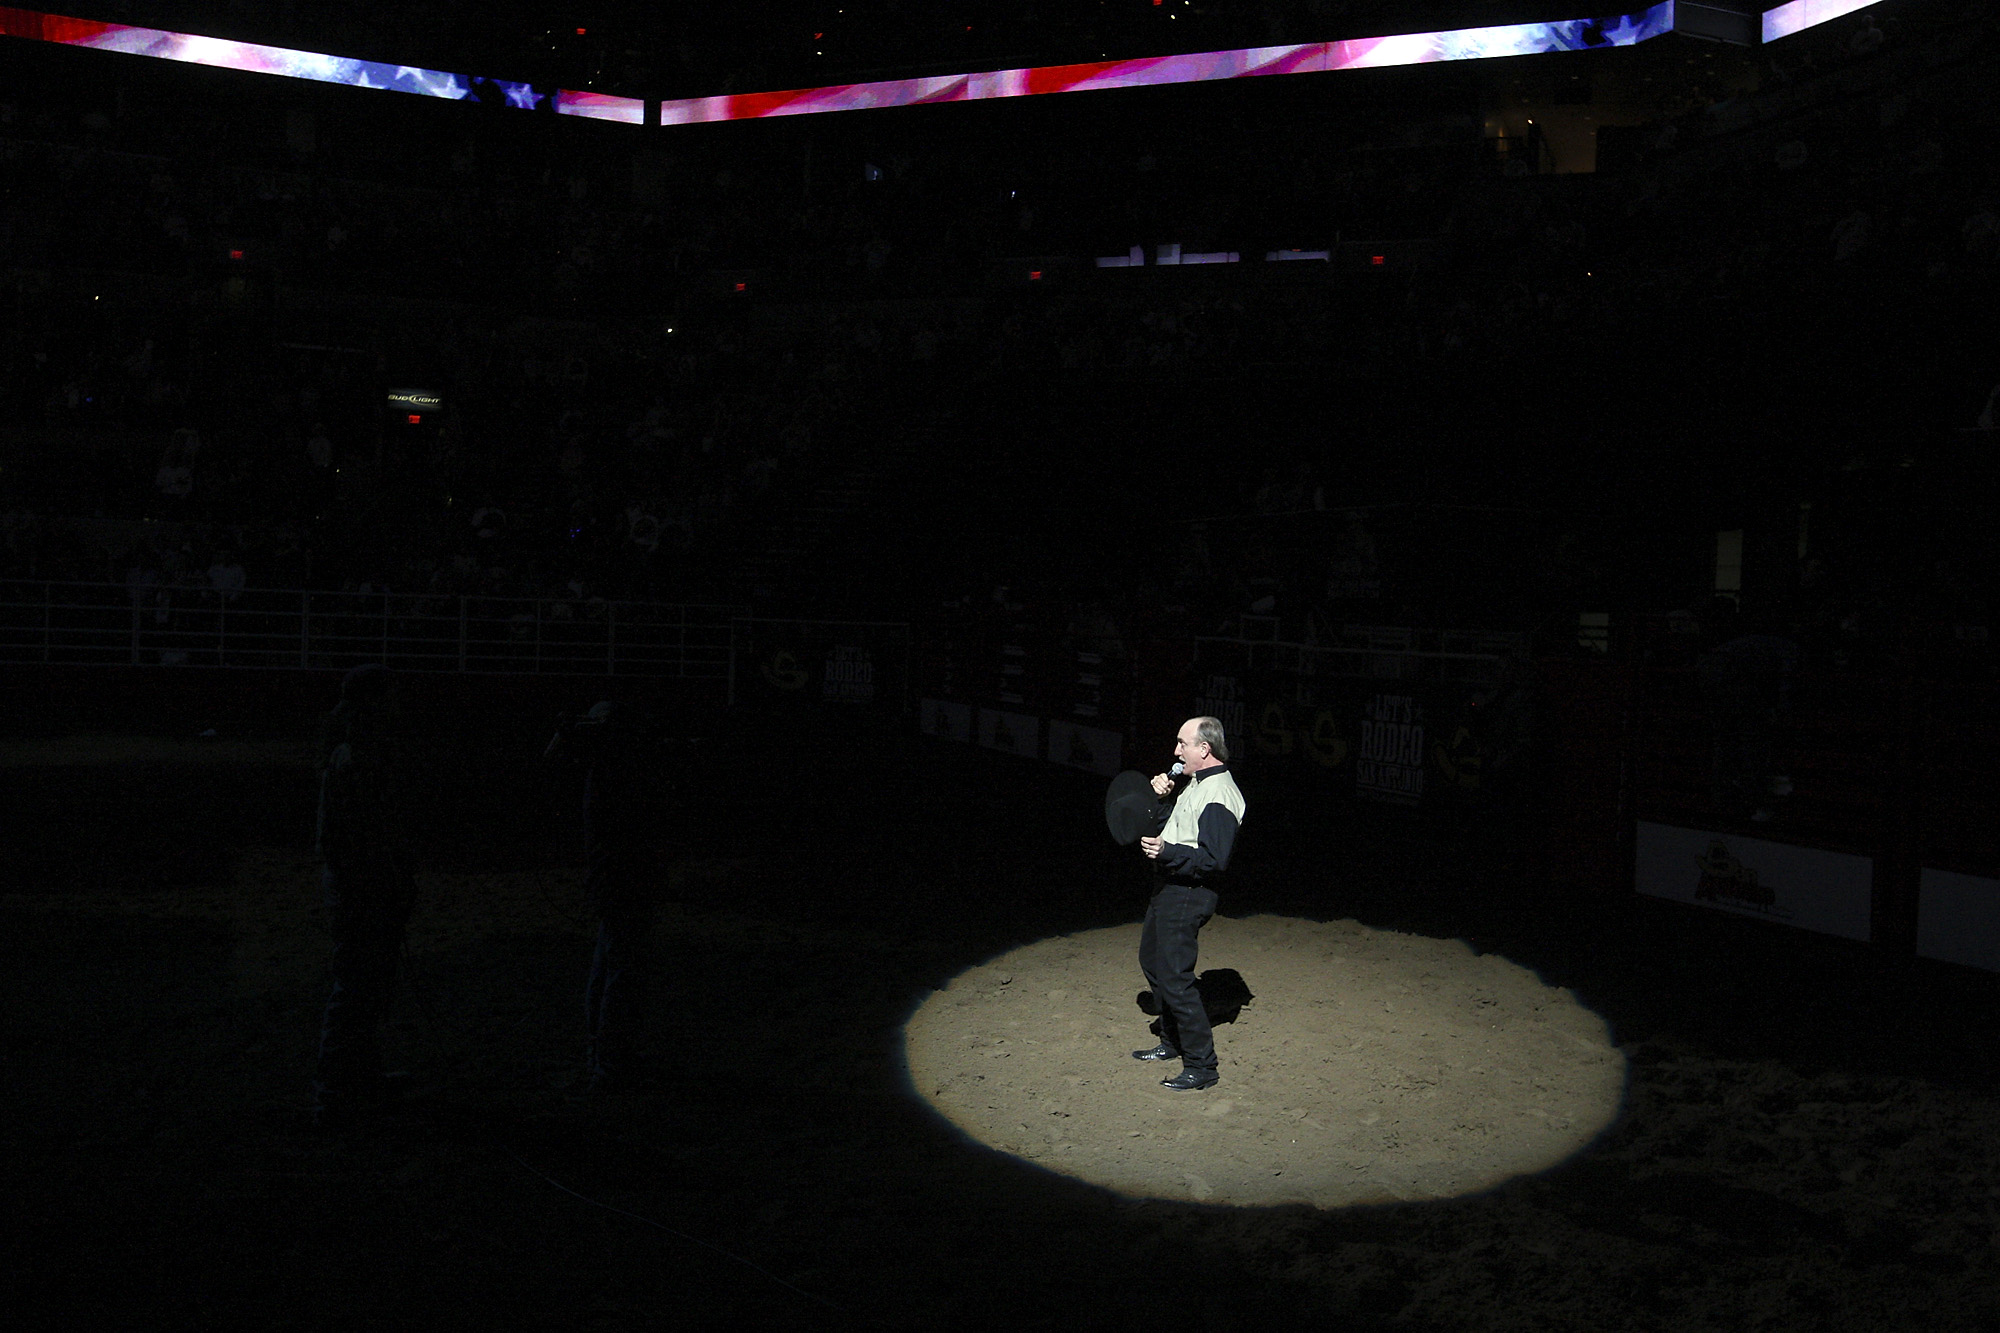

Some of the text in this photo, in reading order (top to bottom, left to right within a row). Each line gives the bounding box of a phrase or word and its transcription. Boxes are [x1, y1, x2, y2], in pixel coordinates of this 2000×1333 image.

[413, 396, 440, 404] LIGHT
[1375, 694, 1412, 724] LET'S
[1360, 719, 1423, 766] RODEO
